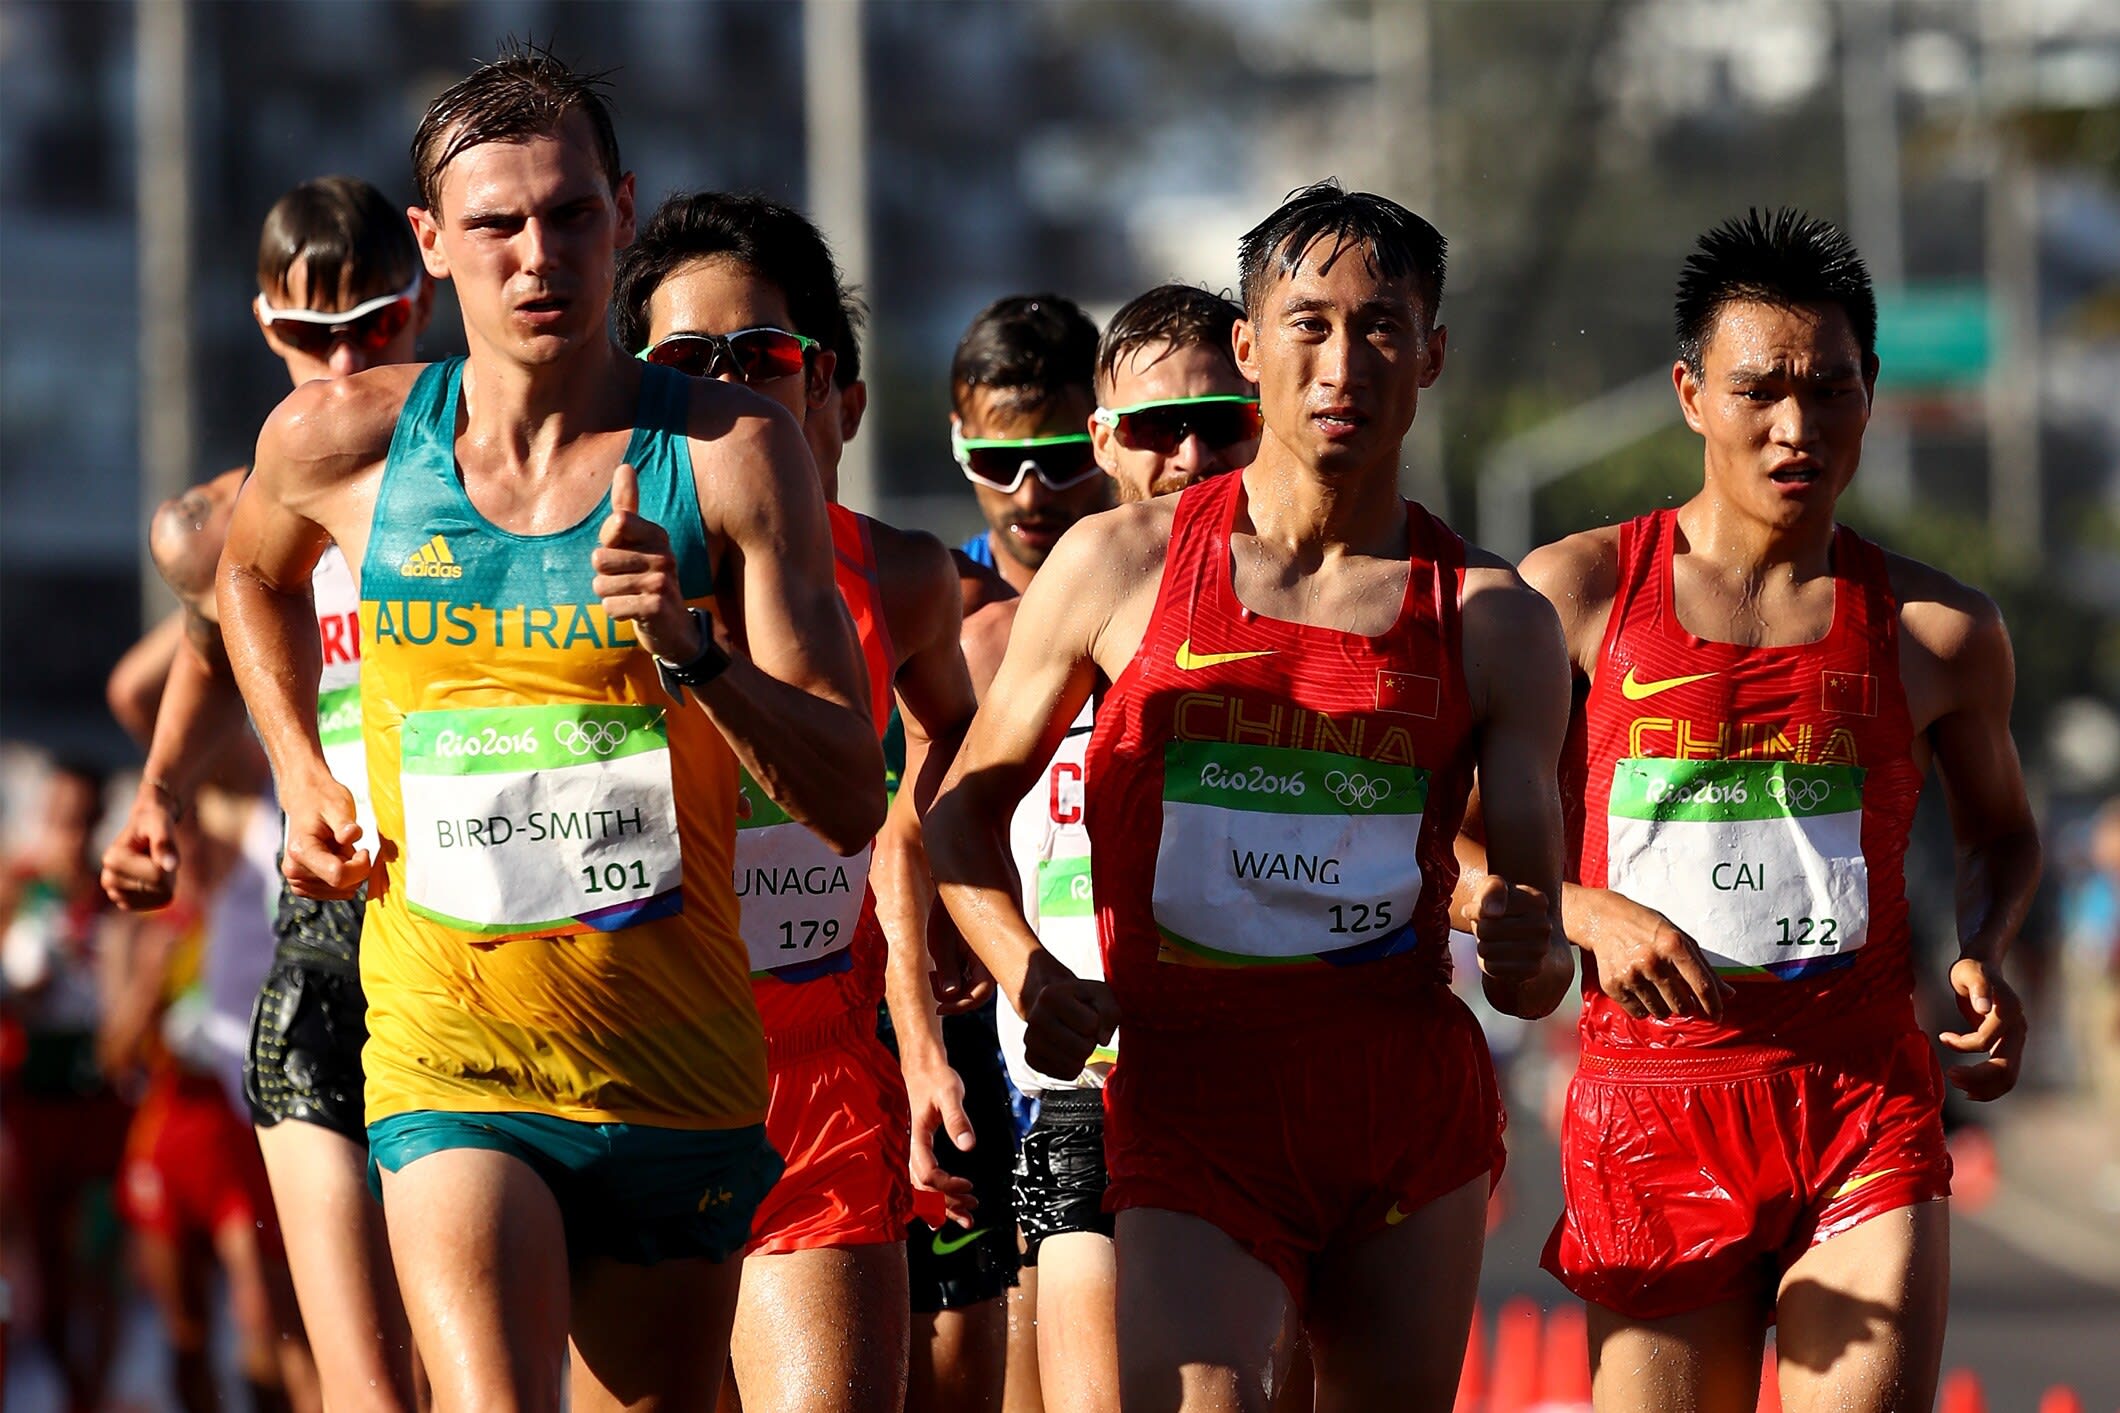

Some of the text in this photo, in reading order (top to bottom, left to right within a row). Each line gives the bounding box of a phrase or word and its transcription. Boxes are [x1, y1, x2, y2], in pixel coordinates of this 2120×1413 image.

[401, 561, 462, 579] adidas
[435, 726, 539, 758] Rio2016
[1173, 692, 1416, 767] CHINA
[1628, 717, 1858, 766] CHINA
[1201, 762, 1306, 797] Rio2016
[1646, 778, 1748, 805] Rio2016
[437, 807, 642, 849] BIRD-SMITH
[582, 859, 651, 895] 101
[1231, 849, 1340, 885] WANG
[1711, 862, 1765, 891] CAI
[779, 919, 840, 949] 179
[1328, 901, 1392, 934] 125
[1775, 917, 1839, 946] 122
